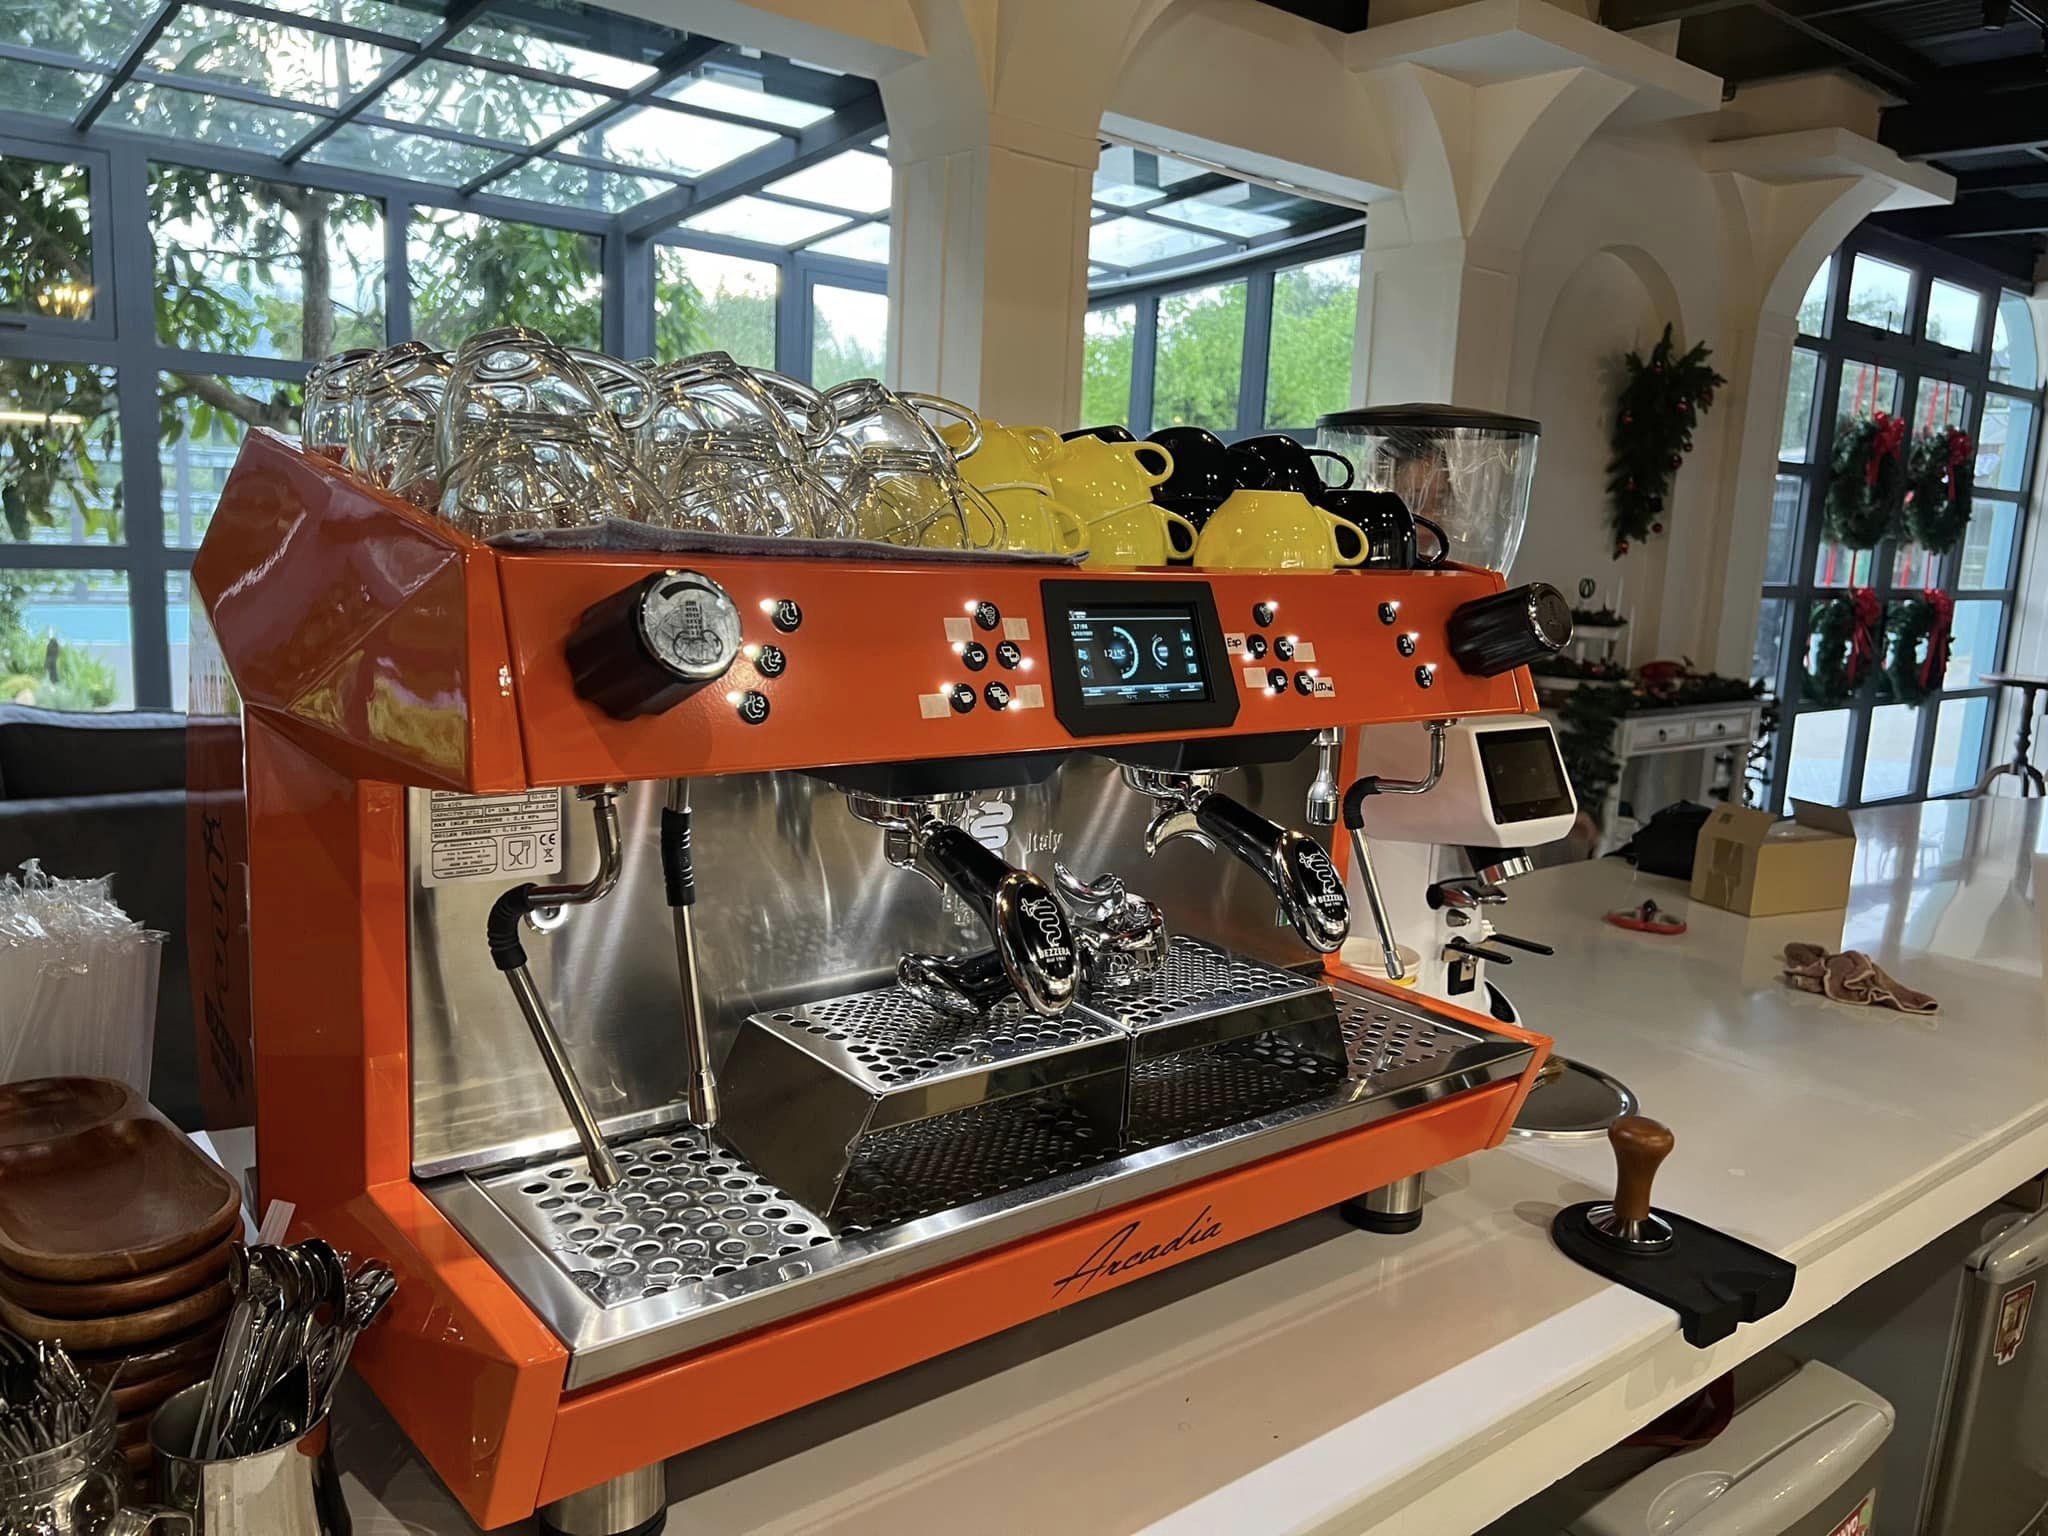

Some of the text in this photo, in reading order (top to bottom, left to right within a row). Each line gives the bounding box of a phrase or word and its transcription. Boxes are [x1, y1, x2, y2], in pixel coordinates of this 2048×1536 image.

[1227, 637, 1242, 648] Esp
[1023, 829, 1063, 854] Italy
[1052, 1205, 1222, 1299] Arcadia
